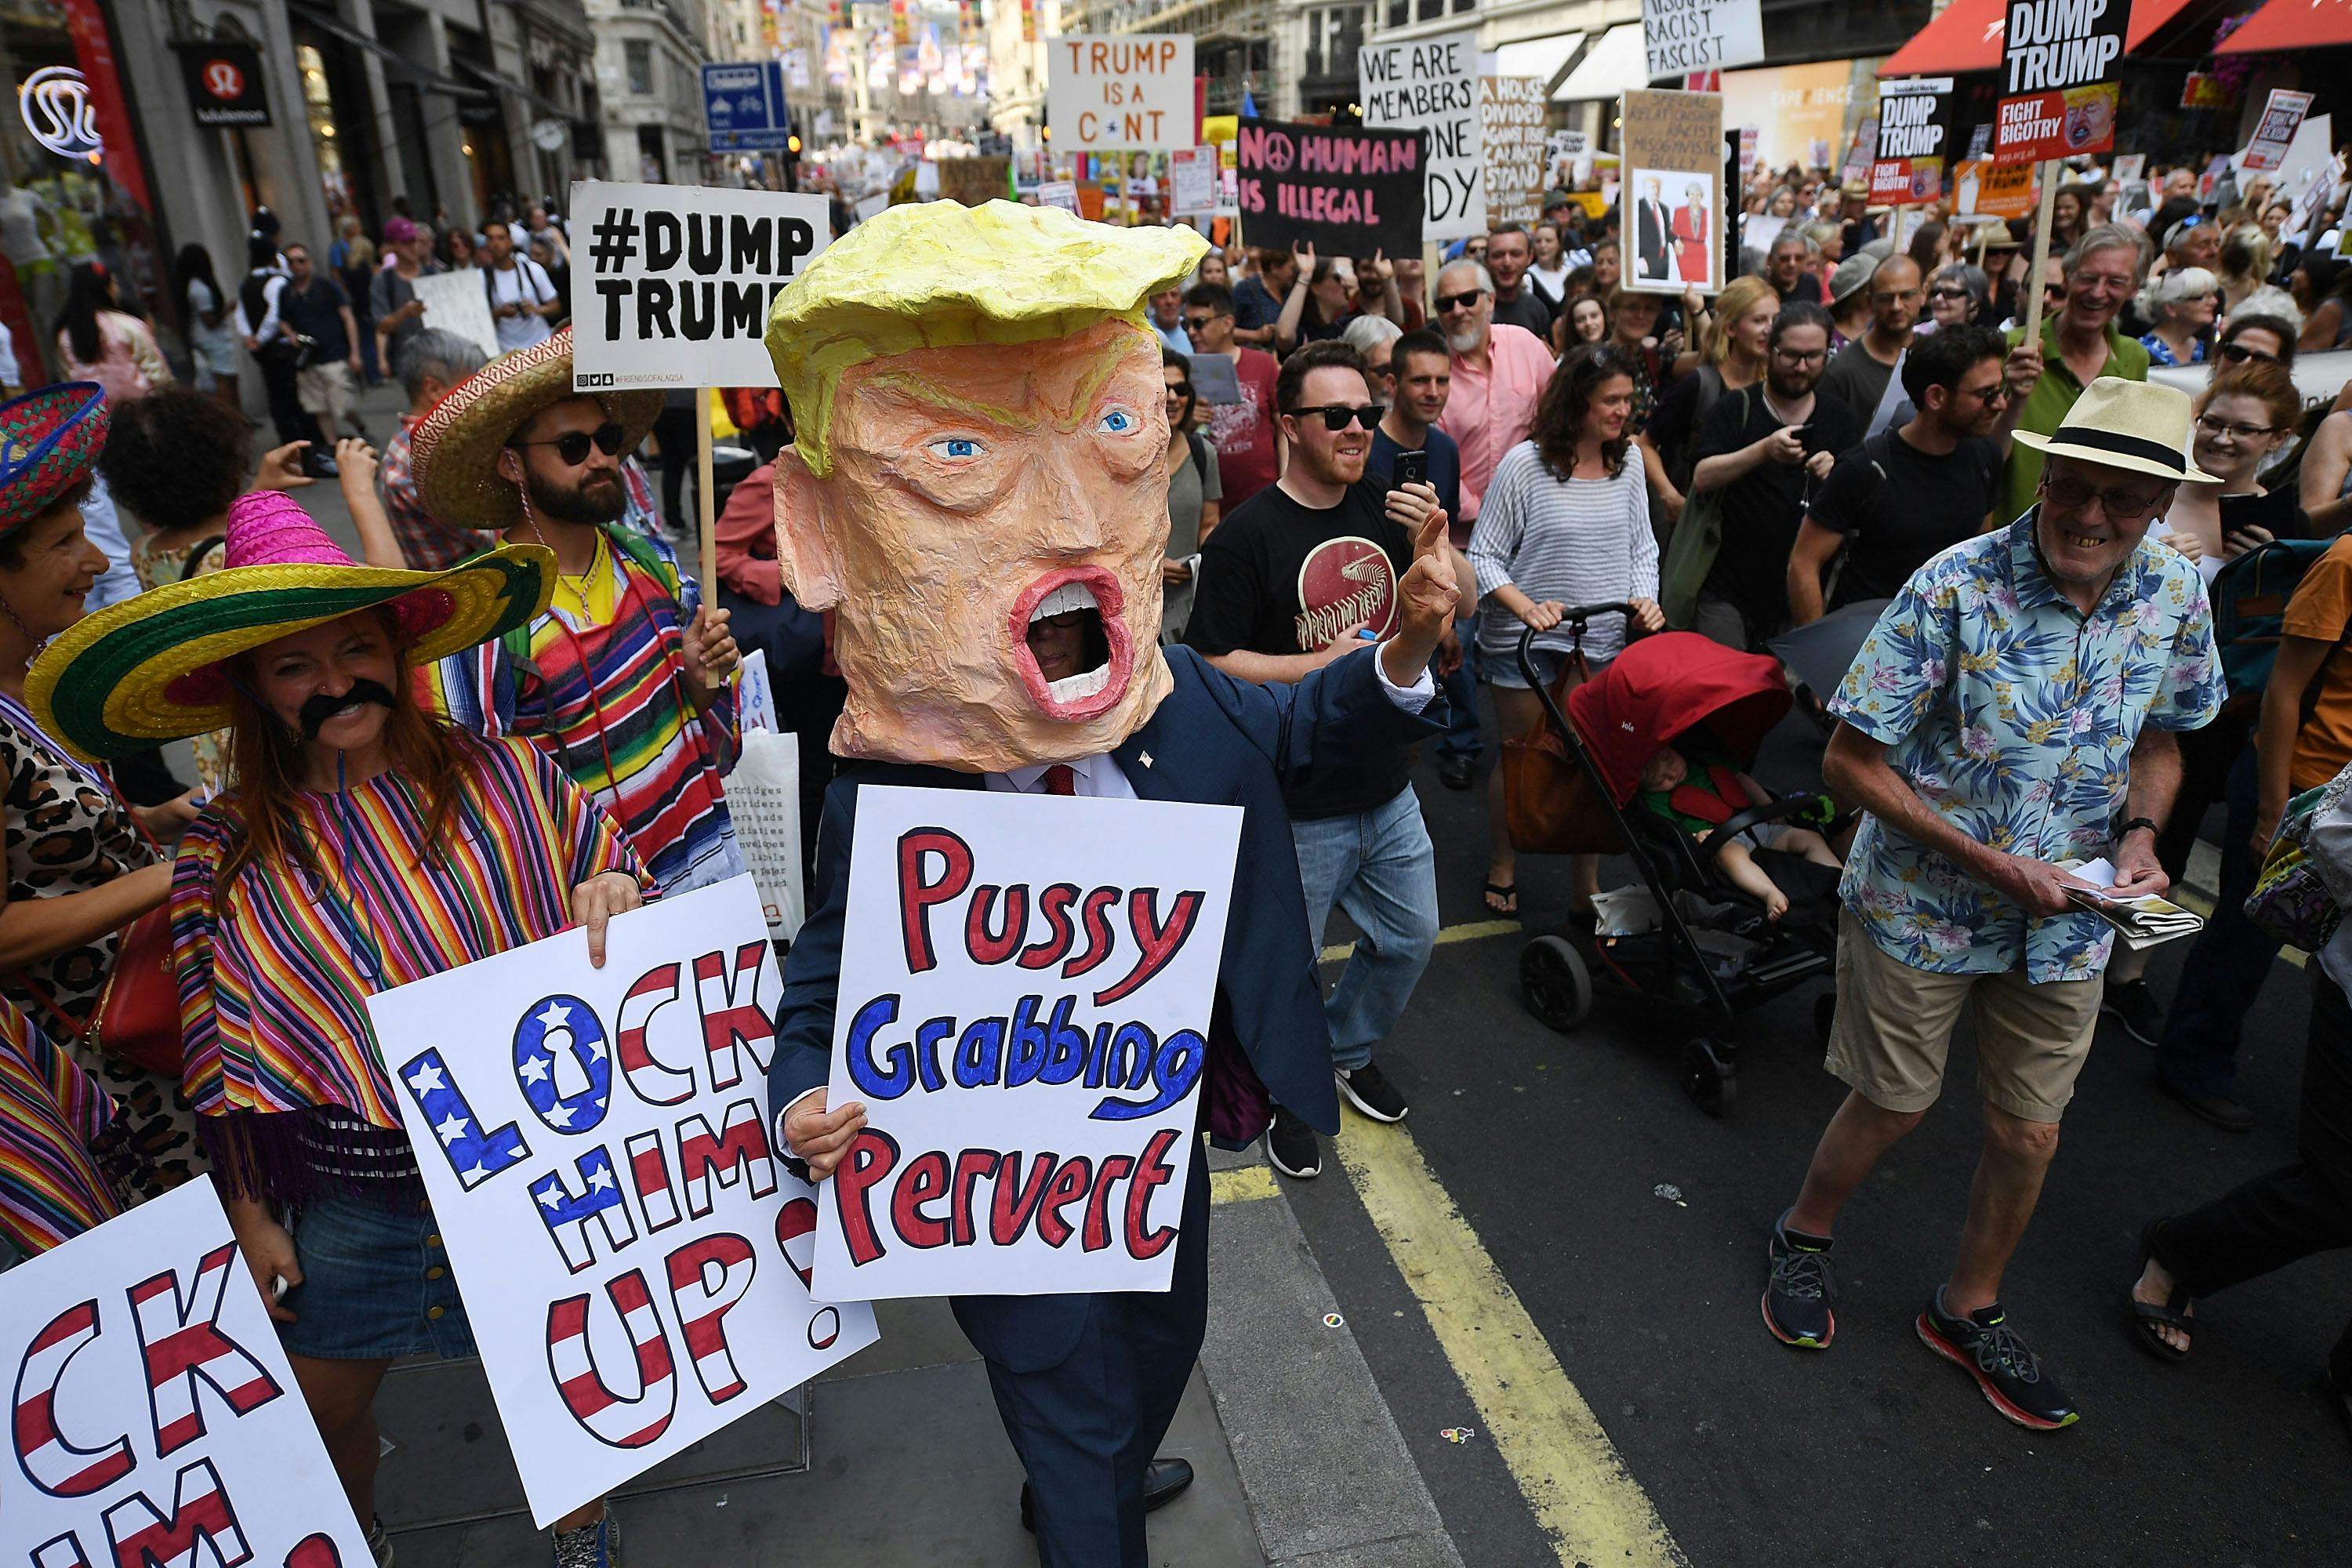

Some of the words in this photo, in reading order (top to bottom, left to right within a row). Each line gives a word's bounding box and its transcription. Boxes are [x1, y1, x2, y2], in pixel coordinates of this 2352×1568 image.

[1645, 9, 1711, 45] RACIST
[2009, 0, 2107, 48] DUMP
[1066, 41, 1177, 74] TRUMP
[1363, 47, 1403, 83] WE
[1413, 42, 1461, 80] ARE
[1647, 35, 1724, 73] FASCIST
[2007, 34, 2120, 93] TRUMP
[1103, 81, 1123, 105] IS
[1131, 82, 1145, 103] A
[1368, 79, 1471, 122] MEMBERS
[1478, 79, 1496, 103] A
[1497, 77, 1546, 103] HOUSE
[1882, 96, 1936, 128] DUMP
[2000, 116, 2063, 145] BIGOTRY
[2002, 99, 2045, 125] FIGHT
[1301, 135, 1417, 175] HUMAN
[1880, 124, 1944, 158] TRUMP
[1486, 164, 1540, 191] STAND
[1872, 175, 1911, 191] BIGOTRY
[1875, 162, 1901, 178] FIGHT
[1240, 178, 1266, 213] IS
[1277, 182, 1380, 225] ILLEGAL
[1429, 167, 1478, 223] DY
[590, 208, 814, 275] #DUMP
[595, 278, 789, 341] TRUM
[725, 786, 782, 796] rtridges
[739, 840, 785, 849] nvelopes
[897, 827, 1206, 1007] Pussy
[397, 938, 776, 1192] LOCK
[846, 994, 1207, 1121] Grabbing
[526, 1098, 779, 1276] HIM
[833, 1127, 1179, 1268] Pervert
[11, 1239, 285, 1498] CK
